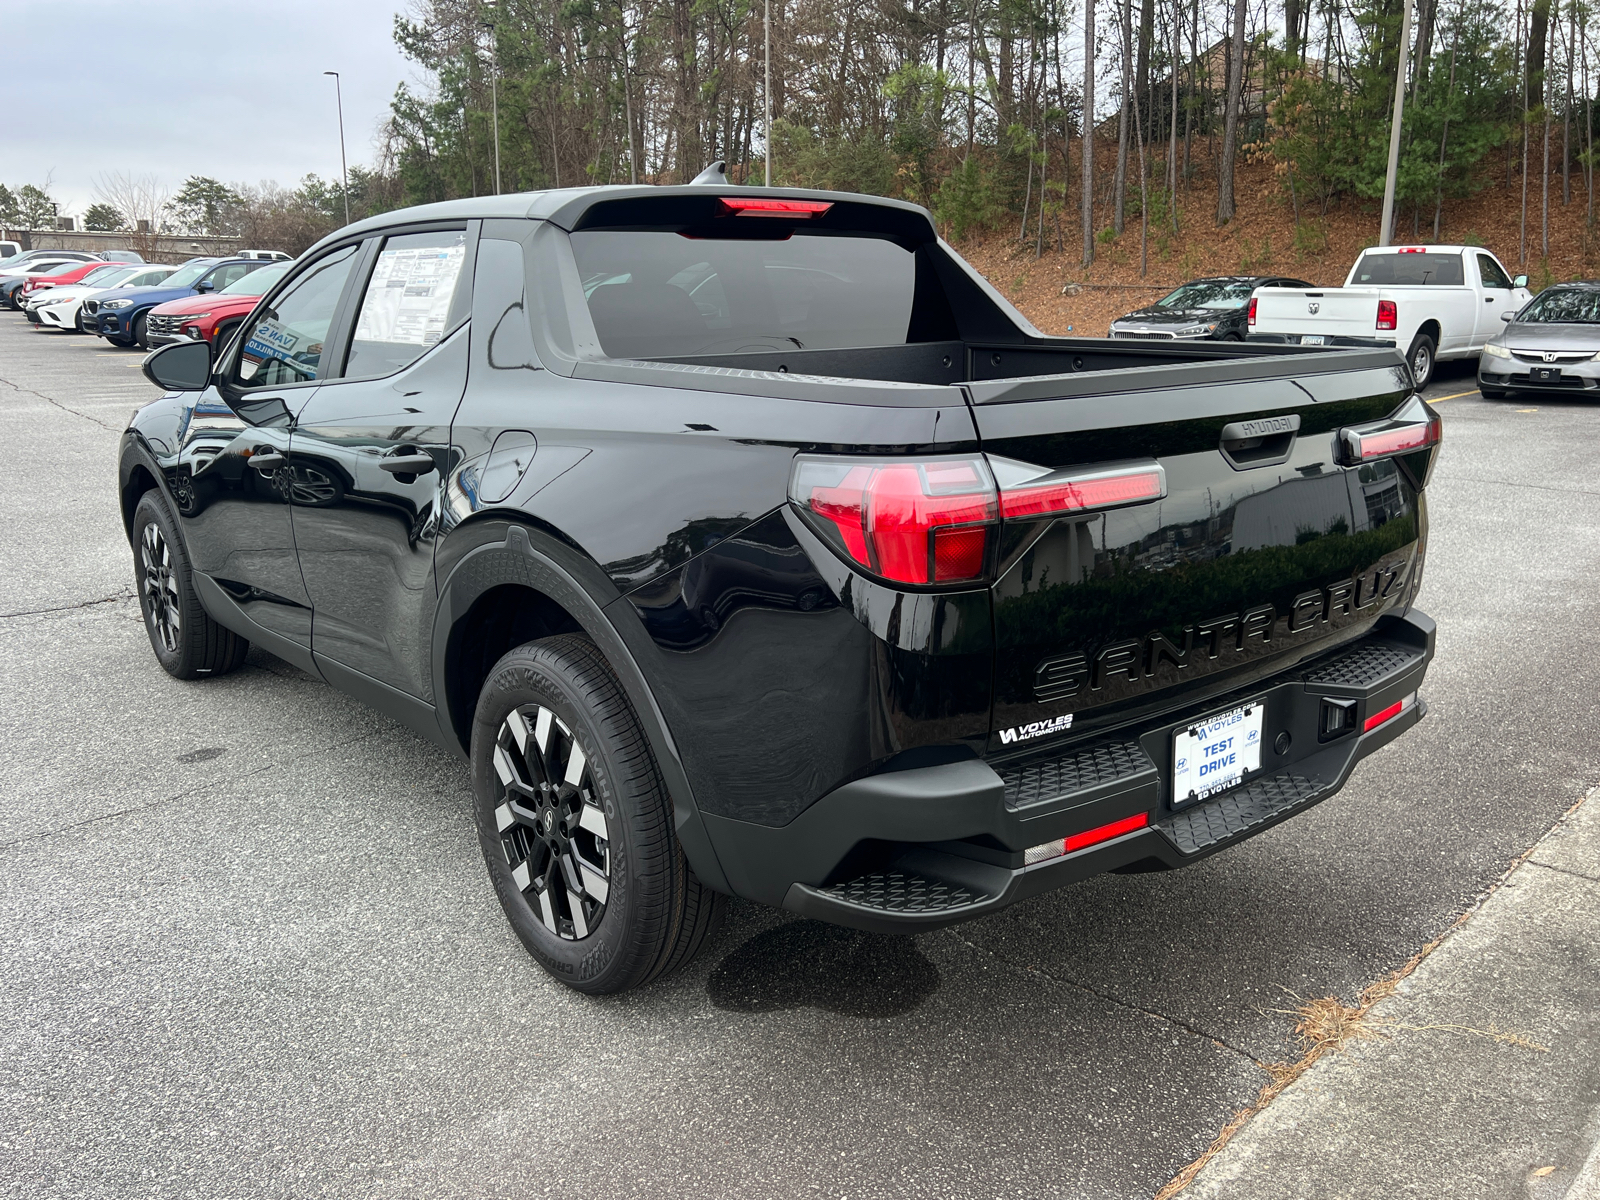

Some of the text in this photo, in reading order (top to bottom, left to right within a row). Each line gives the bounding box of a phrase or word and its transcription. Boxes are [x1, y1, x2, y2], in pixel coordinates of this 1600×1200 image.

[1241, 418, 1293, 436] HYUNDAI
[1033, 559, 1407, 703] SANTA CRUZ
[1018, 713, 1074, 735] VOYLES
[1018, 722, 1072, 741] AUTOMOTIVE
[1207, 713, 1243, 733] VOYLES
[1203, 736, 1234, 758] TEST
[575, 720, 615, 820] KUMHO
[1199, 752, 1236, 777] DRIVE
[1198, 776, 1242, 801] ED VOYLES
